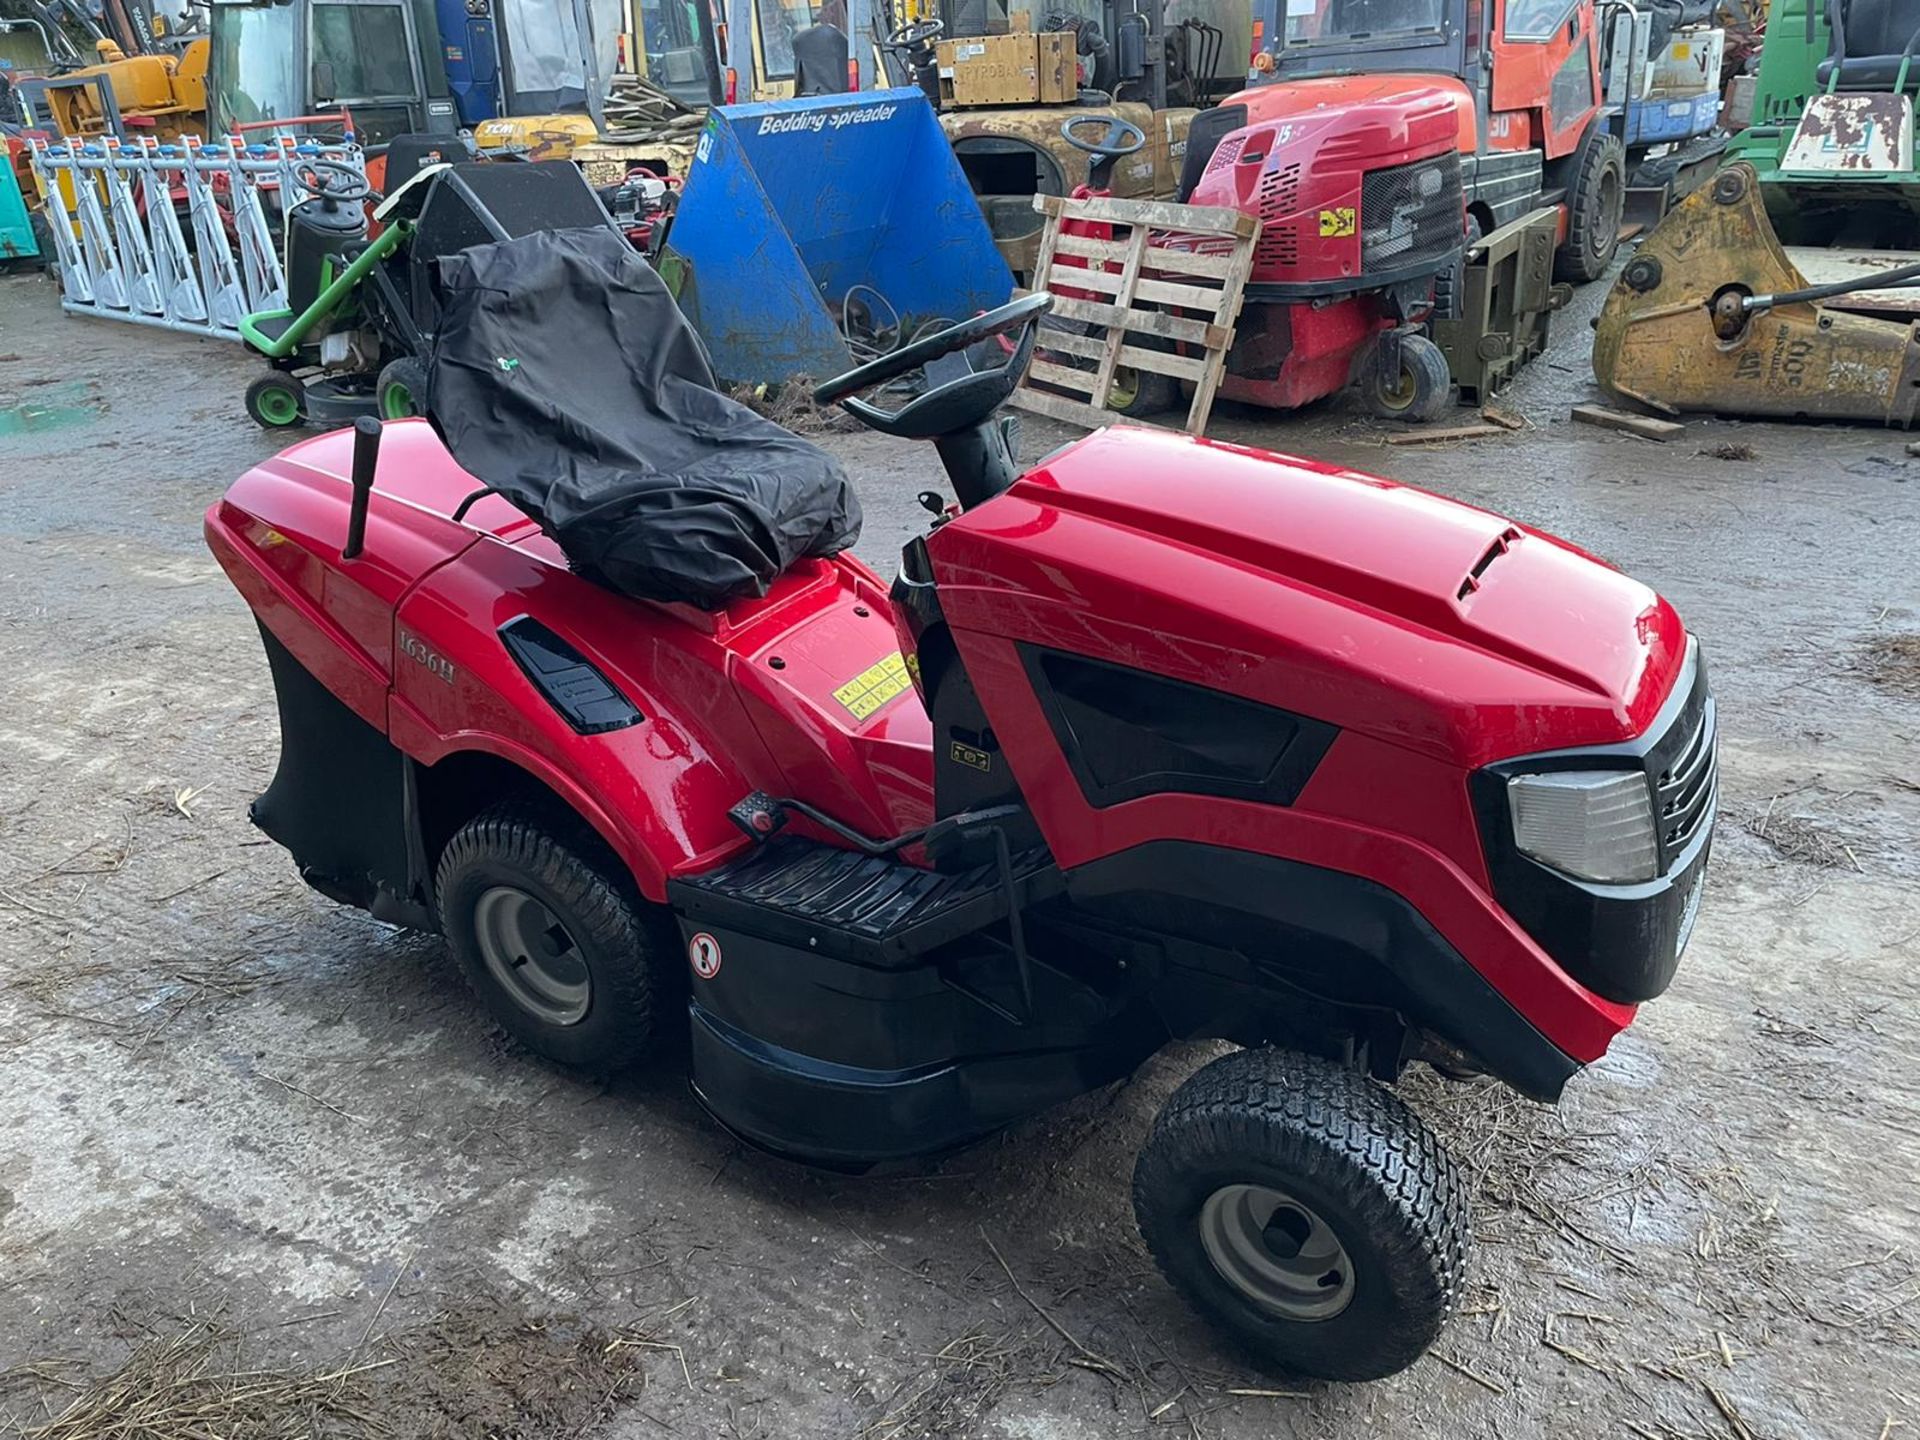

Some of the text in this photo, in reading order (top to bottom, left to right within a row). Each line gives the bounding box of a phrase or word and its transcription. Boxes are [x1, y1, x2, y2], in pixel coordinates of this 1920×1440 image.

[132, 6, 152, 45] TOYOTA
[484, 123, 514, 135] TCM
[758, 111, 827, 136] Bedding
[1733, 351, 1761, 380] JCB
[399, 631, 455, 686] 1636H
